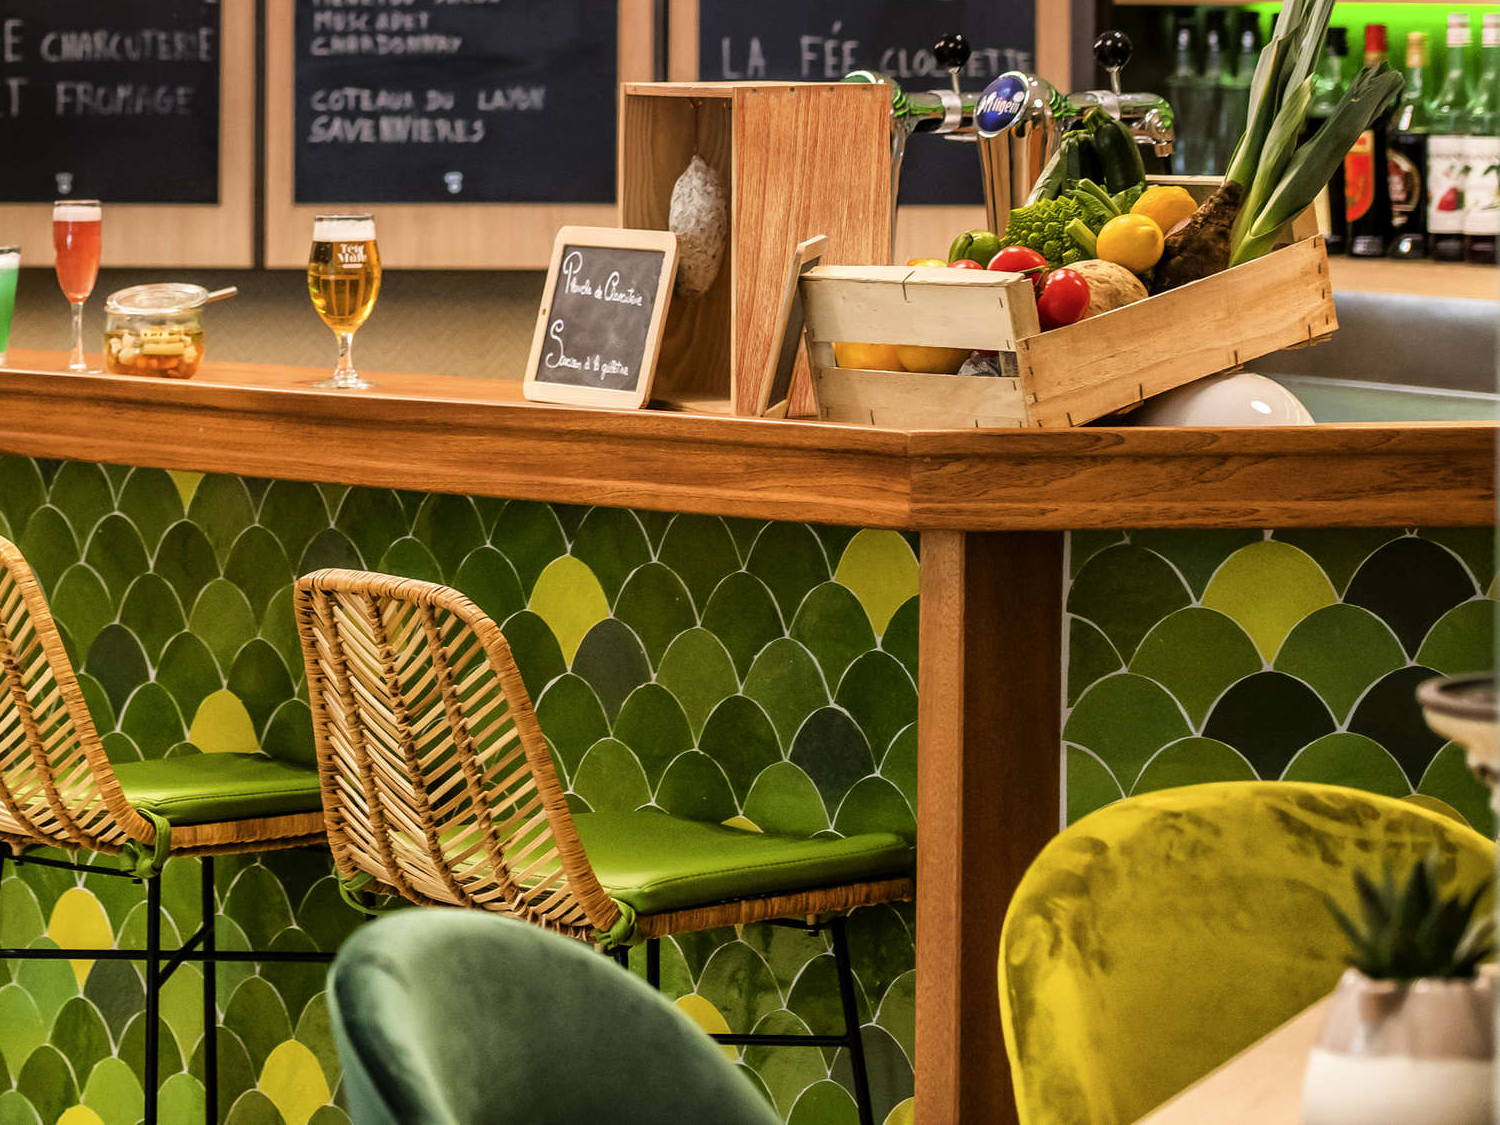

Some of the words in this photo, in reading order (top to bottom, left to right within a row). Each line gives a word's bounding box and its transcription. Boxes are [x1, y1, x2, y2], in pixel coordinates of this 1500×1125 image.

[721, 36, 766, 79] LA
[800, 20, 861, 76] FÉE
[55, 80, 194, 117] FROMAGE
